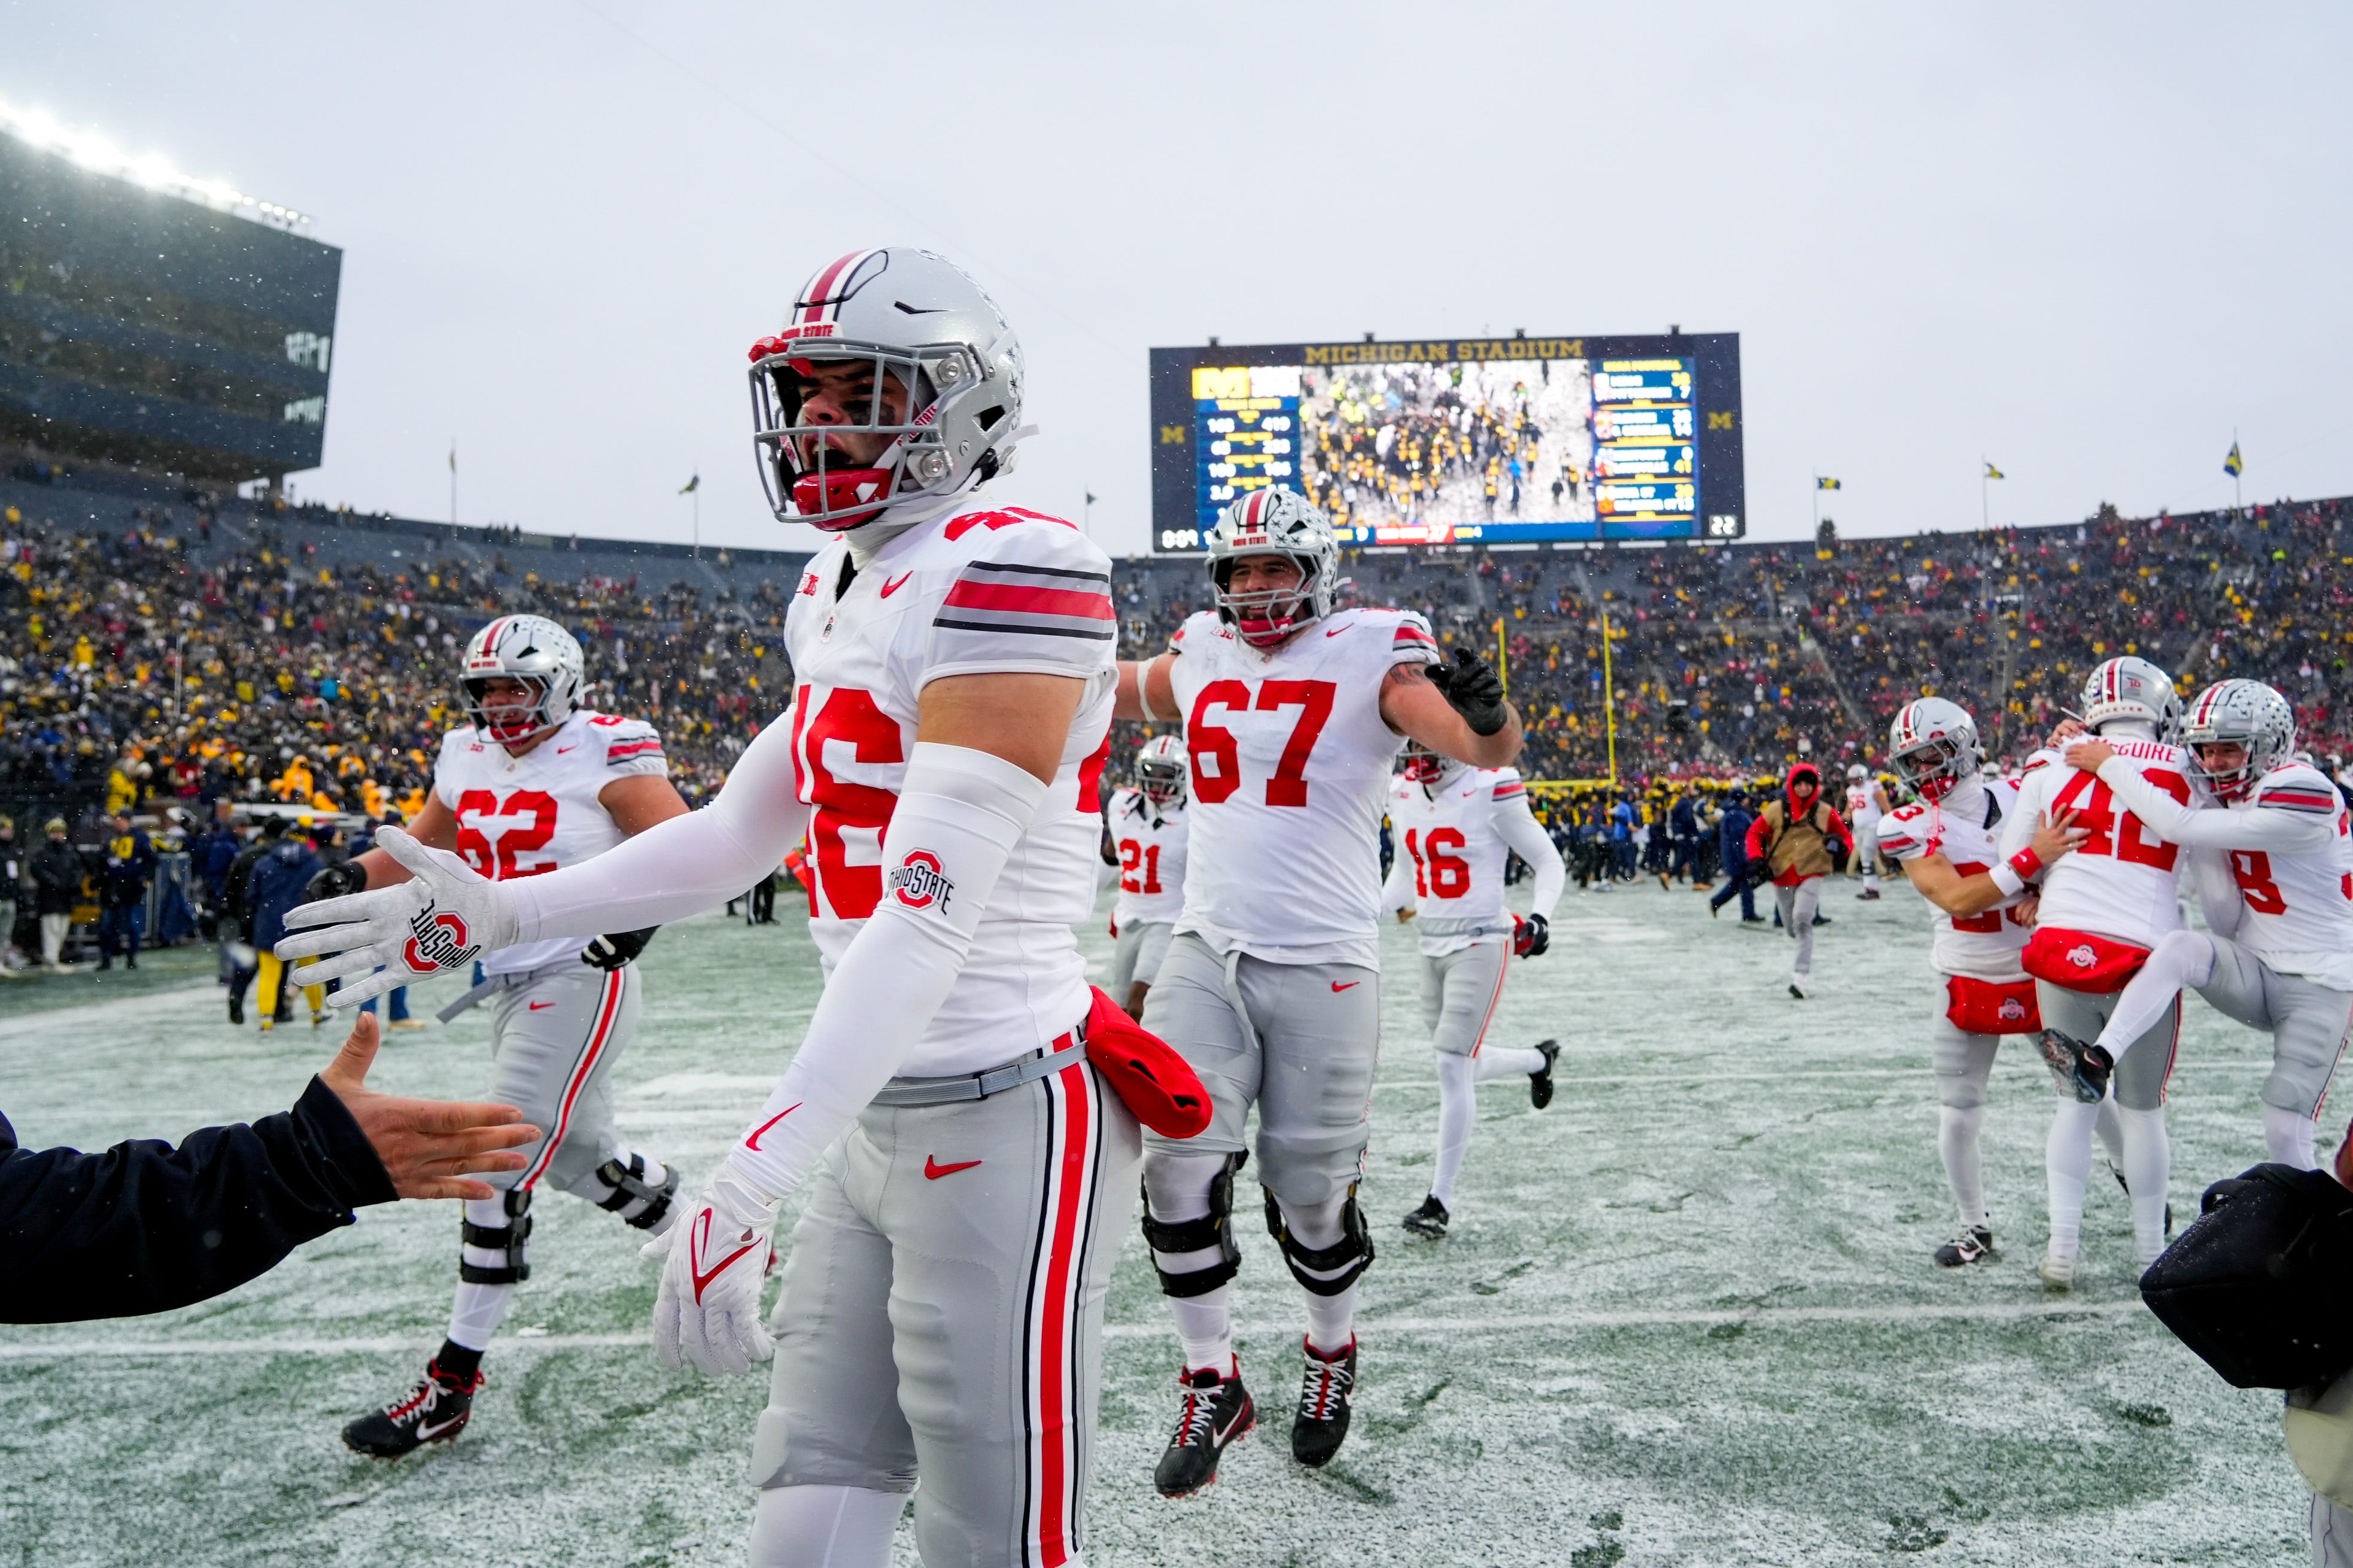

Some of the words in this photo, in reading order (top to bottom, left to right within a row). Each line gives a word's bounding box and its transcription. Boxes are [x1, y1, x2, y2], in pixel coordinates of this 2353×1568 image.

[1305, 343, 1449, 364] MICHIGAN
[1457, 339, 1583, 361] STADIUM
[1191, 366, 1251, 400] M
[1679, 385, 1691, 399] 7
[1673, 422, 1693, 437] 14
[1708, 411, 1733, 430] M
[1160, 426, 1185, 444] M
[1681, 446, 1694, 460] 0
[1674, 459, 1692, 473] 41
[1355, 526, 1369, 541] 9
[1711, 516, 1735, 535] 22
[1162, 529, 1198, 548] 0:09
[1188, 680, 1337, 808] 67
[2095, 738, 2178, 763] GUIRE
[2051, 768, 2191, 872] 42
[456, 790, 558, 881] 62
[1119, 838, 1163, 894] 21
[1404, 827, 1470, 899] 16
